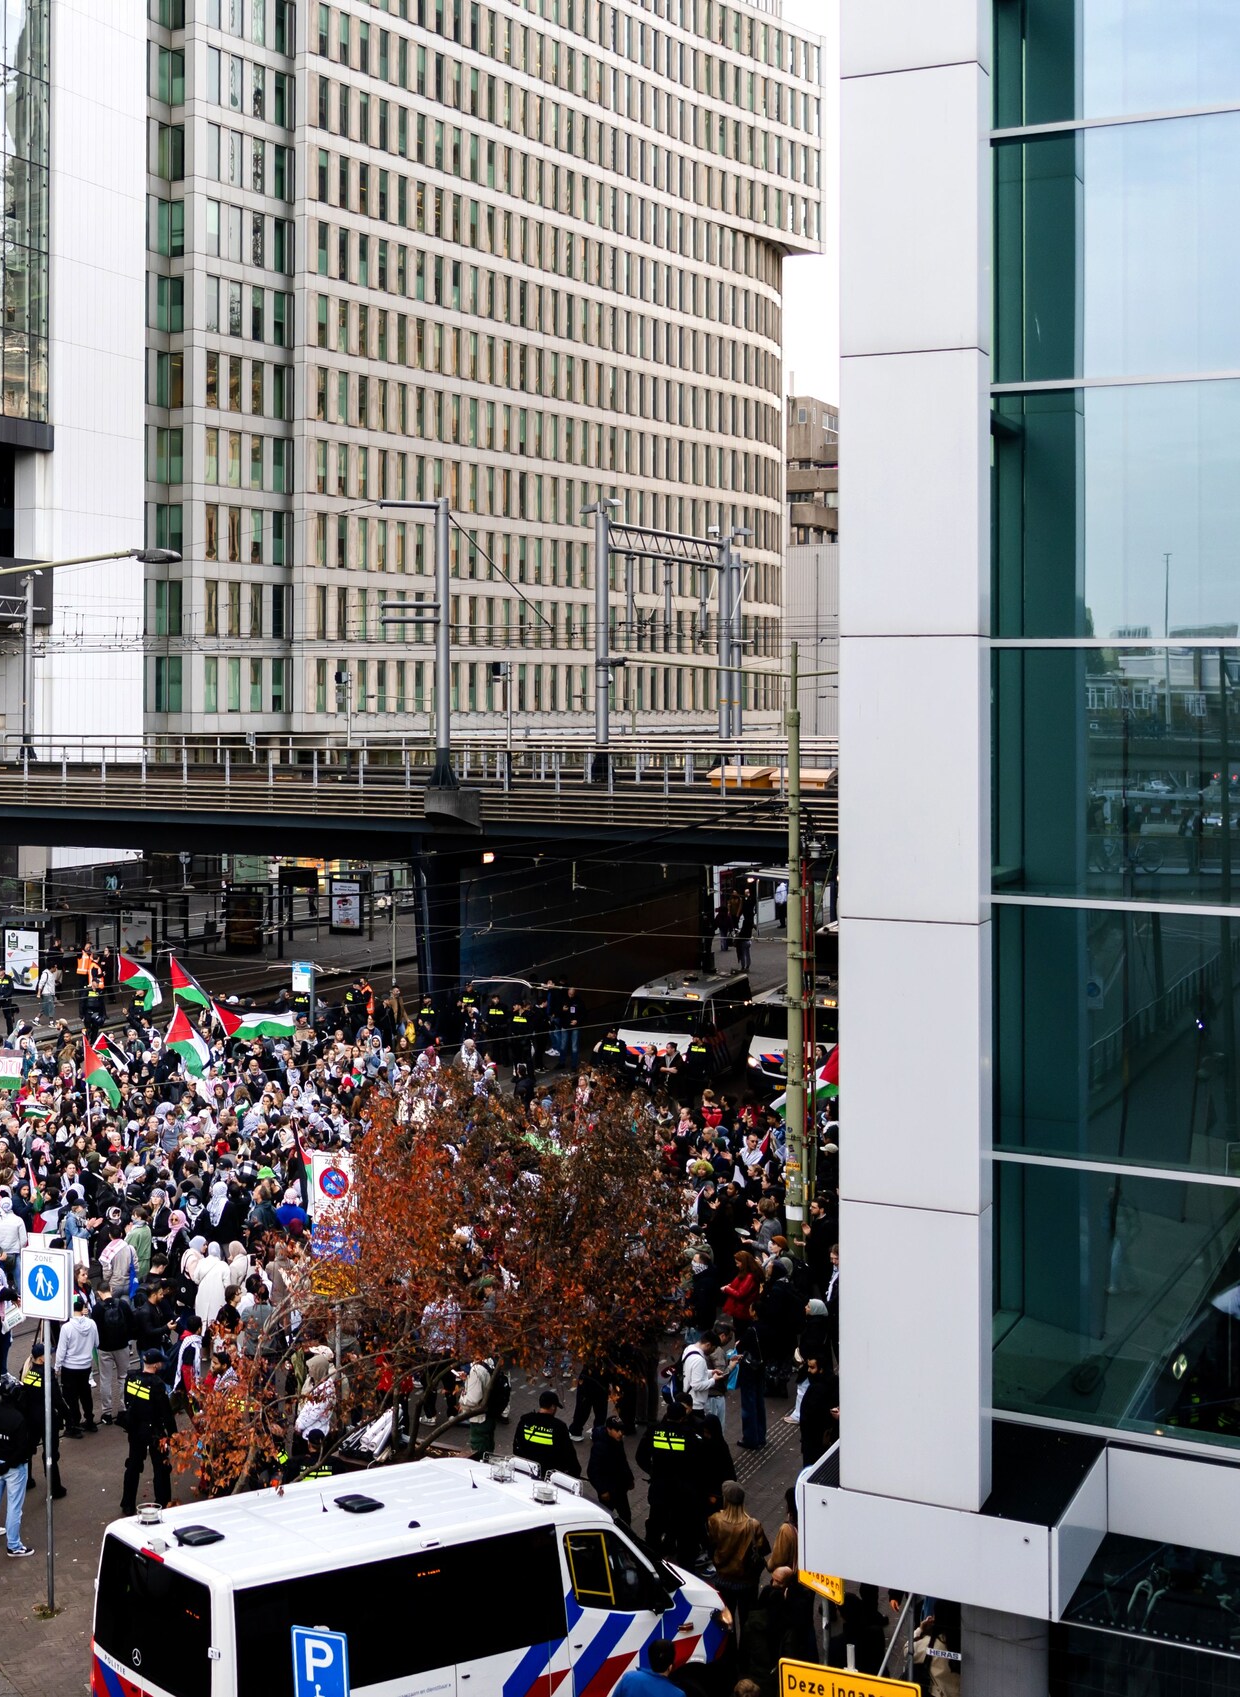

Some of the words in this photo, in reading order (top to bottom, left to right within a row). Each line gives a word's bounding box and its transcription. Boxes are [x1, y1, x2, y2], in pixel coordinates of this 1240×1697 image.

[34, 1254, 53, 1263] ZONE
[103, 1654, 126, 1676] POLITIE
[305, 1638, 334, 1682] P
[928, 1649, 960, 1660] HERAS
[788, 1674, 825, 1696] Deze
